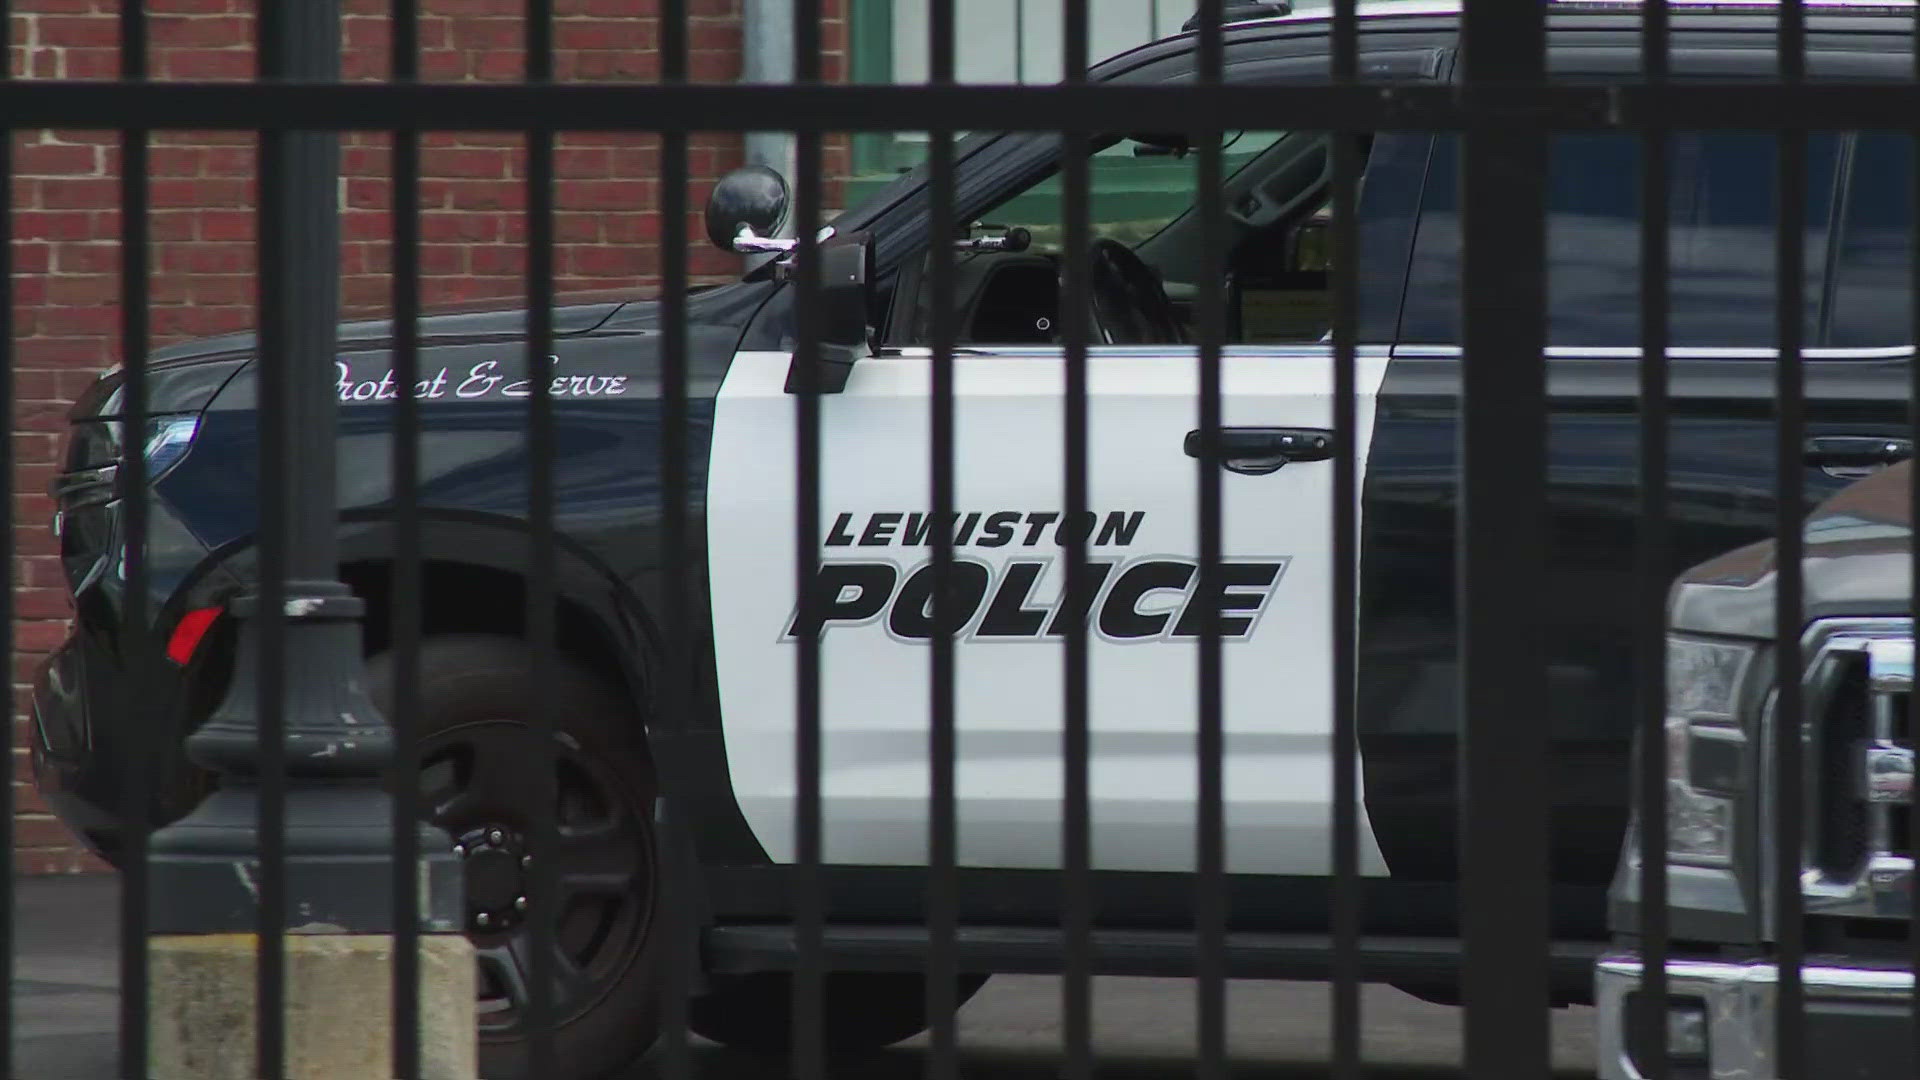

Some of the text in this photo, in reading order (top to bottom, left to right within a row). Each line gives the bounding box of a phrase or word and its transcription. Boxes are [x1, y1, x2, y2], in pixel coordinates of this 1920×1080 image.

[335, 361, 448, 401] rotct
[455, 360, 503, 399] &
[824, 511, 1146, 547] LEWISTON
[777, 555, 1293, 643] POLICE
